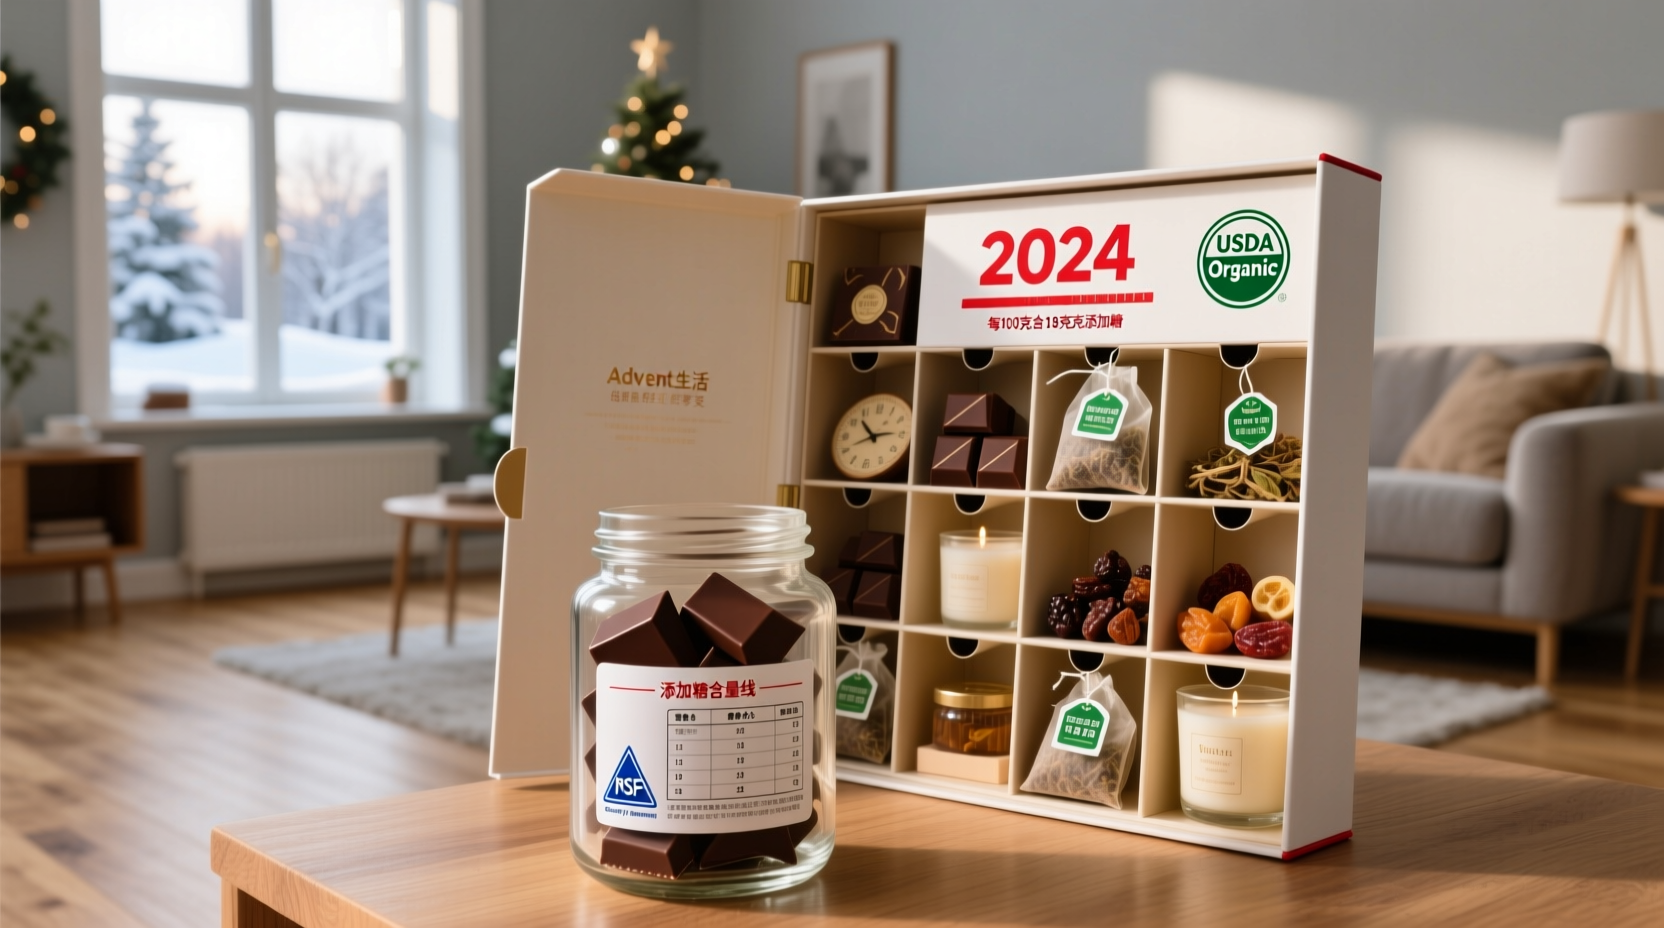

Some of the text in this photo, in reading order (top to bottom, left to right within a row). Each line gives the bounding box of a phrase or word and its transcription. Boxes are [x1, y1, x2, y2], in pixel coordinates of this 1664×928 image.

[979, 223, 1136, 287] 2024
[1216, 232, 1275, 254] USDA
[1207, 258, 1279, 284] Organic
[606, 366, 710, 392] Advent生活
